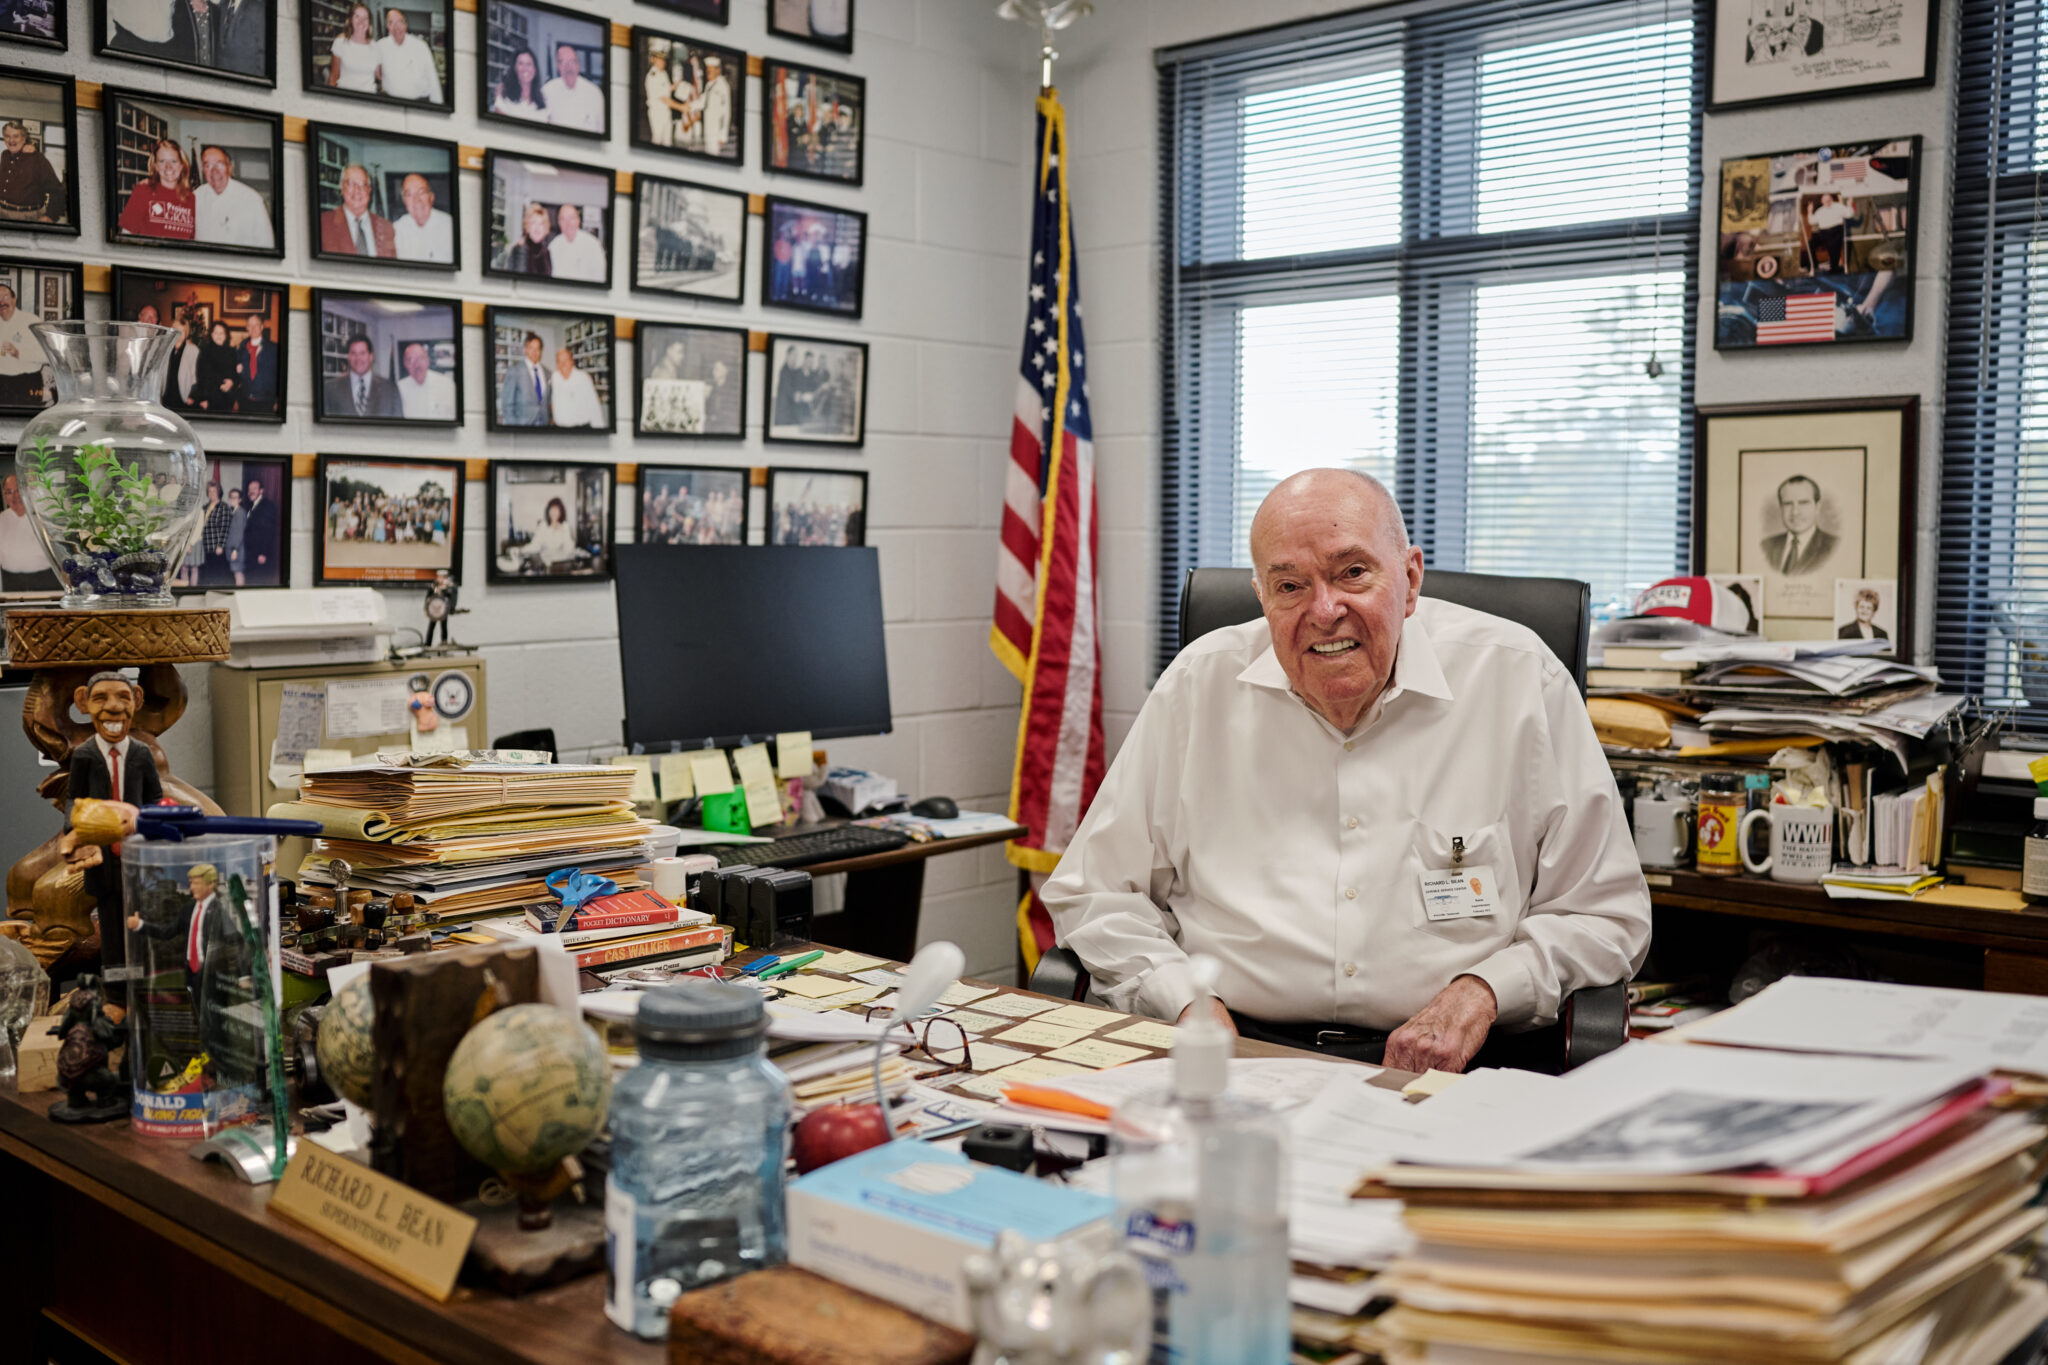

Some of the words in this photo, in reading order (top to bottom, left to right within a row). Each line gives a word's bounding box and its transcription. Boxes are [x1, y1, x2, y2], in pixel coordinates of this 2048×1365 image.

[583, 919, 604, 928] POCKET
[605, 914, 650, 926] DICTIONARY
[604, 948, 626, 963] CAS
[629, 939, 671, 959] WALKER
[300, 1154, 373, 1210] RICHARD
[397, 1202, 449, 1247] BEAN
